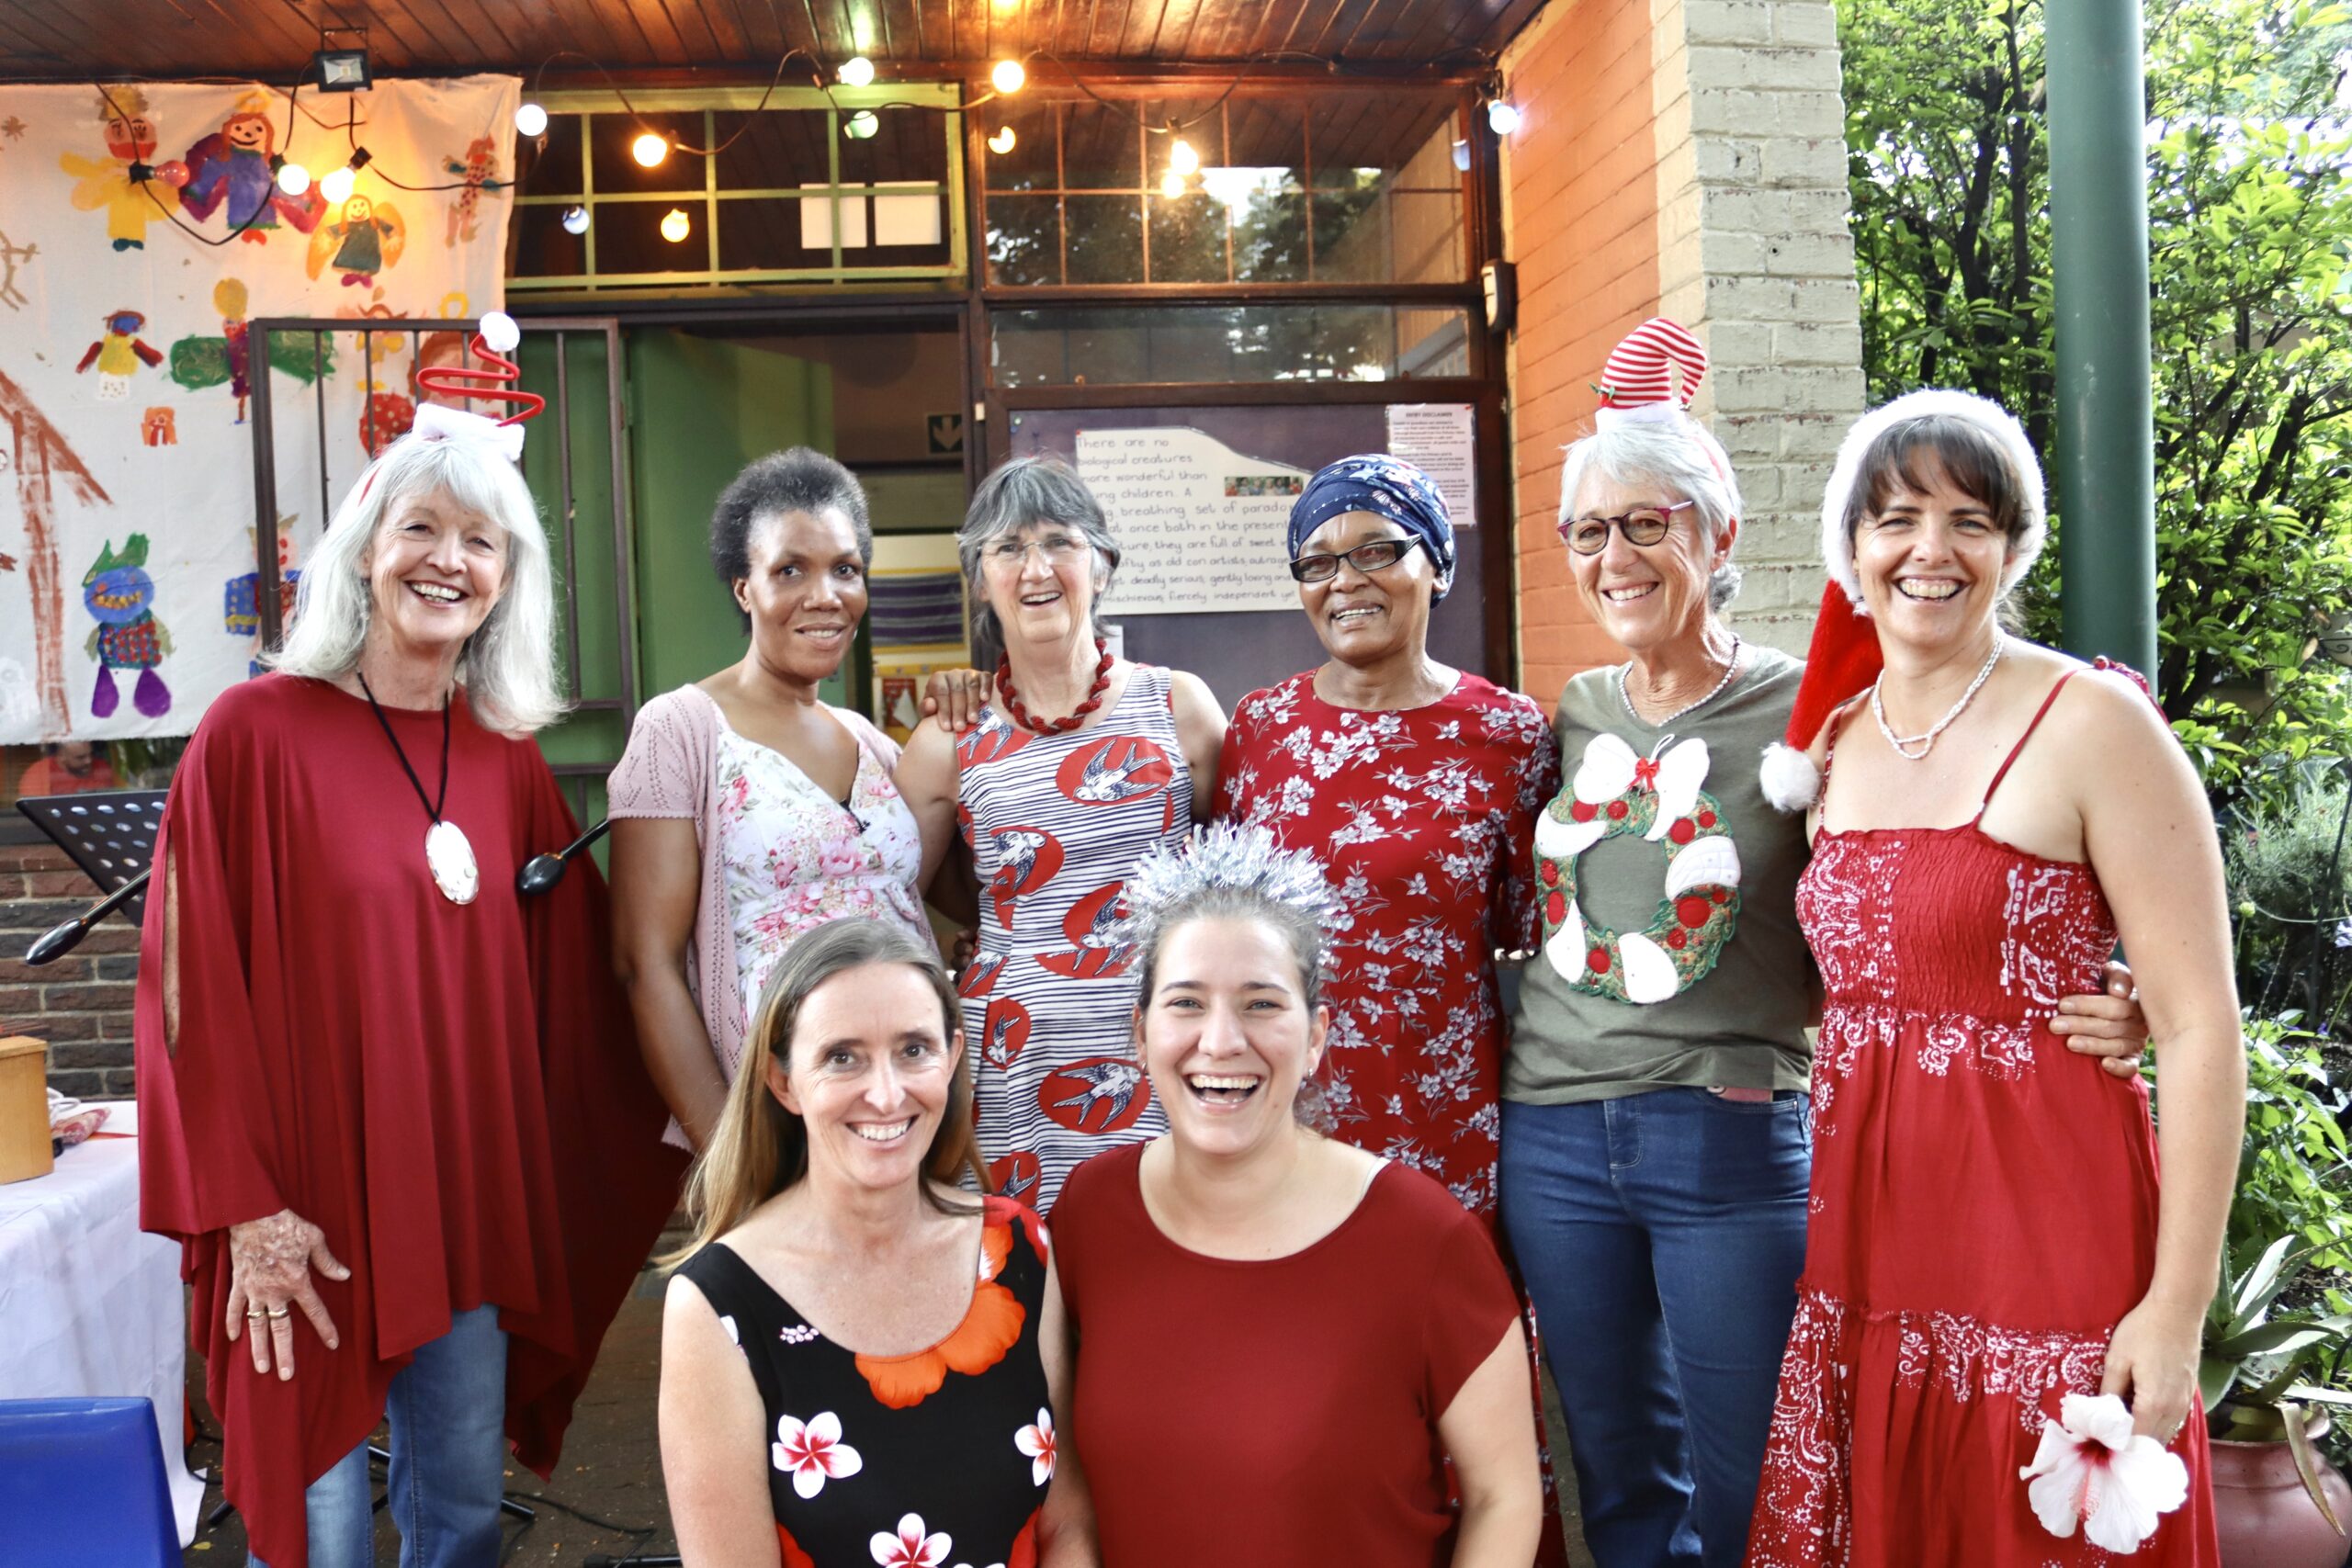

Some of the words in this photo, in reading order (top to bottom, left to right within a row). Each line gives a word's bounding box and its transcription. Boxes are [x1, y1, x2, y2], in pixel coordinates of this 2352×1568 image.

[1078, 438, 1115, 448] There
[1125, 439, 1146, 447] are
[1154, 439, 1169, 447] no
[1077, 453, 1127, 469] biological
[1131, 455, 1193, 464] creatures
[1116, 469, 1174, 481] wonderful
[1179, 471, 1208, 480] than
[1184, 487, 1192, 497] A
[1120, 504, 1185, 519] breathing
[1195, 502, 1216, 514] set
[1223, 501, 1237, 513] of
[1129, 525, 1160, 533] once
[1164, 519, 1196, 533] both
[1216, 520, 1238, 531] the
[1155, 540, 1182, 554] they
[1210, 535, 1227, 548] full
[1232, 536, 1244, 547] of
[1250, 537, 1275, 547] sweet
[1148, 559, 1162, 568] as
[1167, 556, 1182, 566] old
[1131, 573, 1166, 589] deadly
[1210, 573, 1243, 587] gently
[1245, 572, 1272, 586] loving
[1170, 591, 1206, 604] fiercely
[1214, 590, 1276, 602] independent
